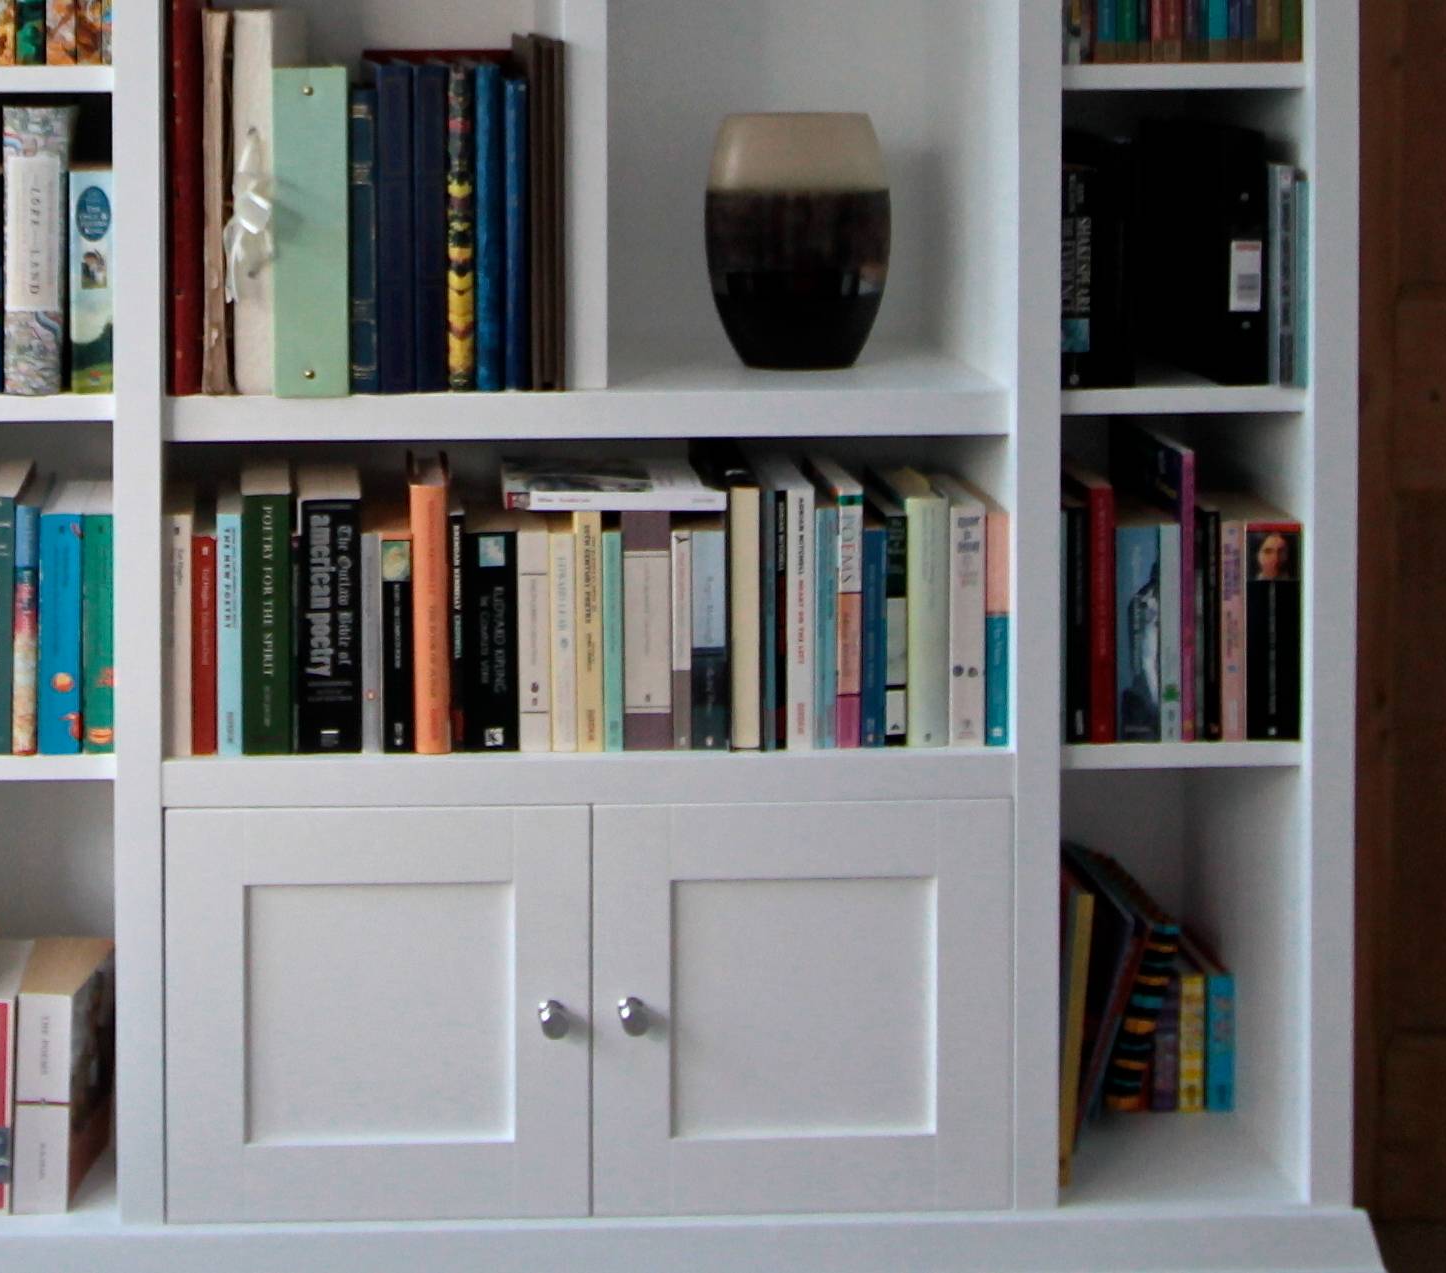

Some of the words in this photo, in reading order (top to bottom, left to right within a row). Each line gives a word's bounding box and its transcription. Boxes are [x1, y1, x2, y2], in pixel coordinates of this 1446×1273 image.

[262, 506, 274, 561] POETRY
[797, 497, 805, 533] ADRIAN
[223, 527, 232, 550] THE
[336, 524, 353, 551] The
[453, 524, 462, 567] BRENDAN
[797, 534, 805, 577] MITCHELL
[841, 514, 856, 584] POEMS
[223, 554, 232, 581] NEW
[262, 567, 274, 595] FOR
[310, 514, 336, 610] american
[336, 556, 353, 606] Outlaw
[583, 548, 592, 589] CENTURY
[223, 584, 232, 629] POETRY
[453, 568, 462, 611] KENNELLY
[262, 599, 274, 626] THE
[336, 611, 353, 647] Bible
[492, 586, 507, 646] RUDYARD
[262, 632, 274, 678] SPIRIT
[304, 612, 335, 678] poetry
[336, 651, 353, 666] of
[492, 650, 507, 693] KIPLING
